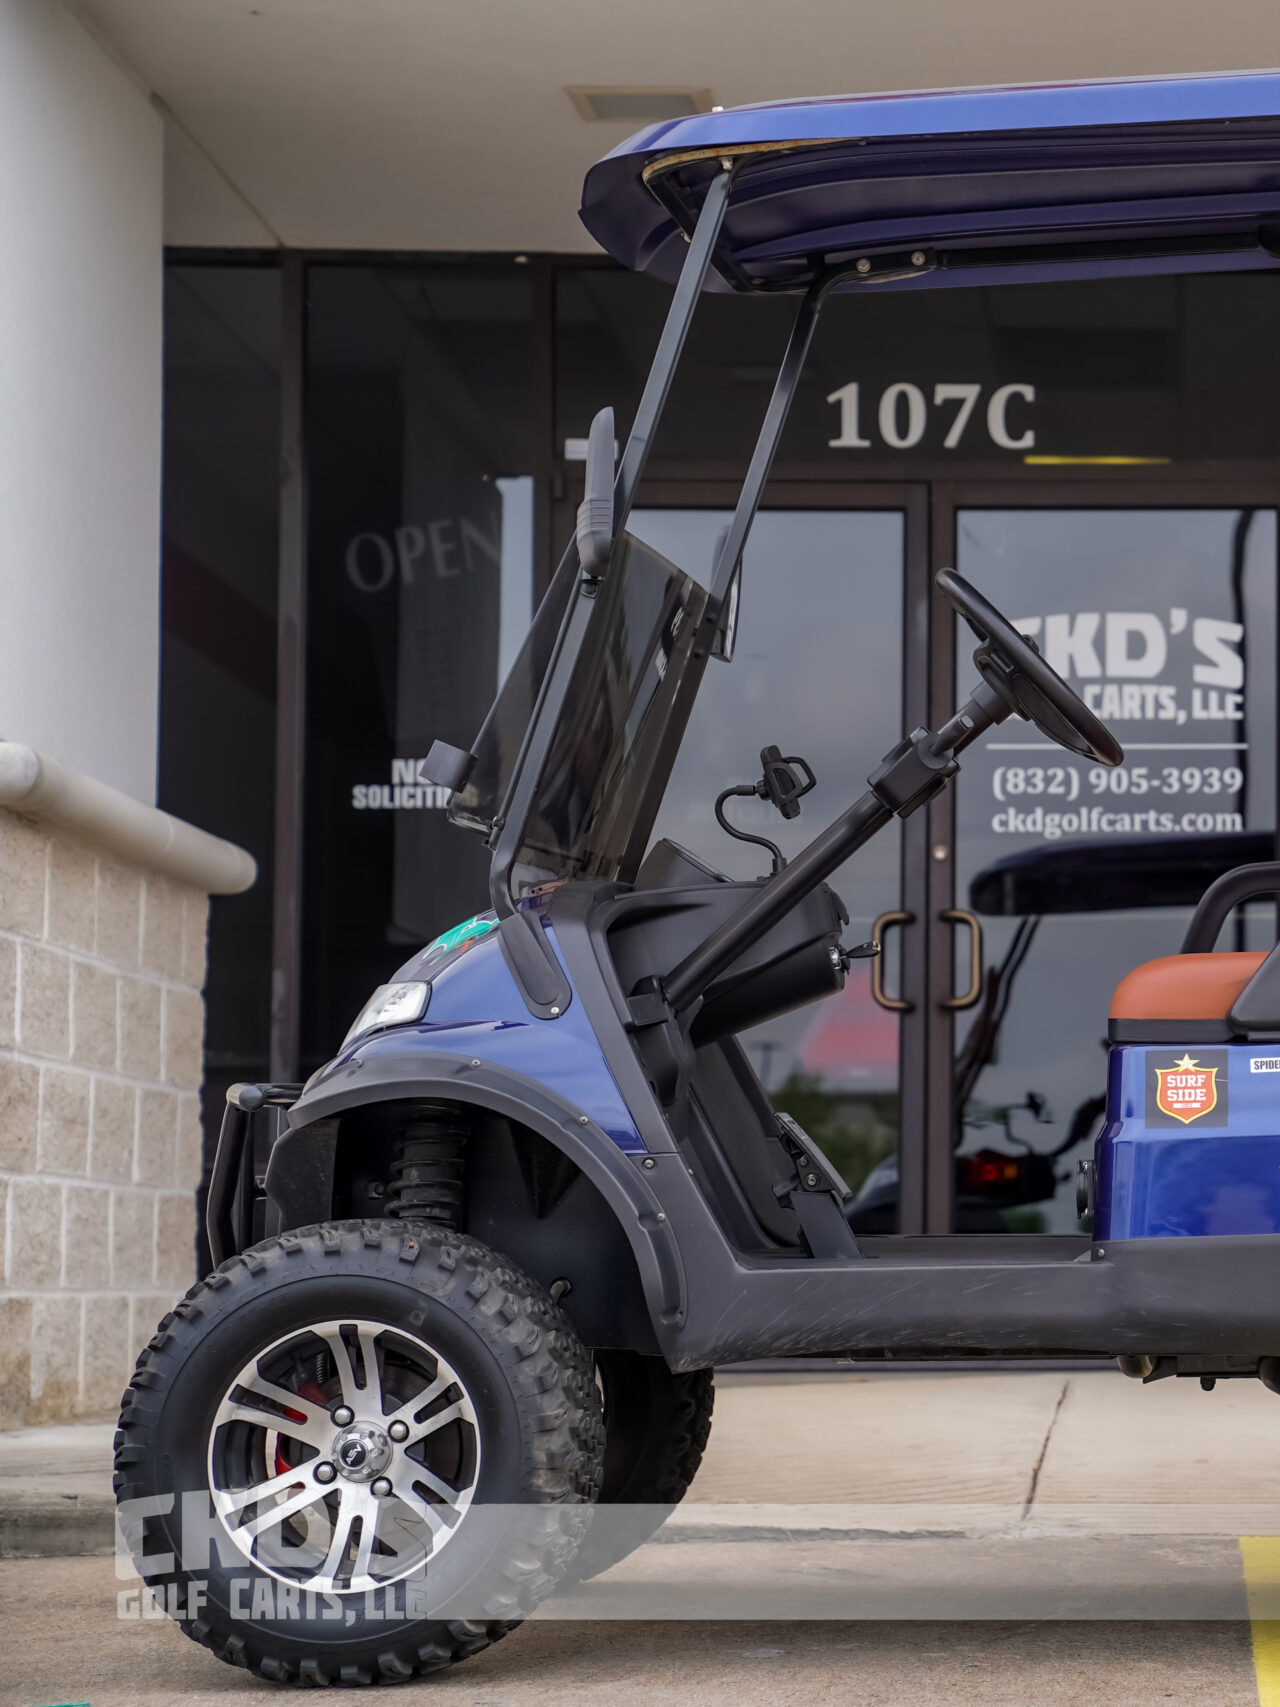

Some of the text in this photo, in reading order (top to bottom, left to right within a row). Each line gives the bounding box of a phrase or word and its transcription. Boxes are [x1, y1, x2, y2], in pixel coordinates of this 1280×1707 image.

[827, 382, 1035, 449] 107C
[345, 510, 502, 593] OPEN
[1192, 688, 1244, 720] LLC
[992, 766, 1244, 802] (832) 905-3939
[991, 805, 1244, 840] ckdgolfcarts.com
[1167, 1074, 1206, 1088] SURF
[1167, 1088, 1207, 1102] SIDE
